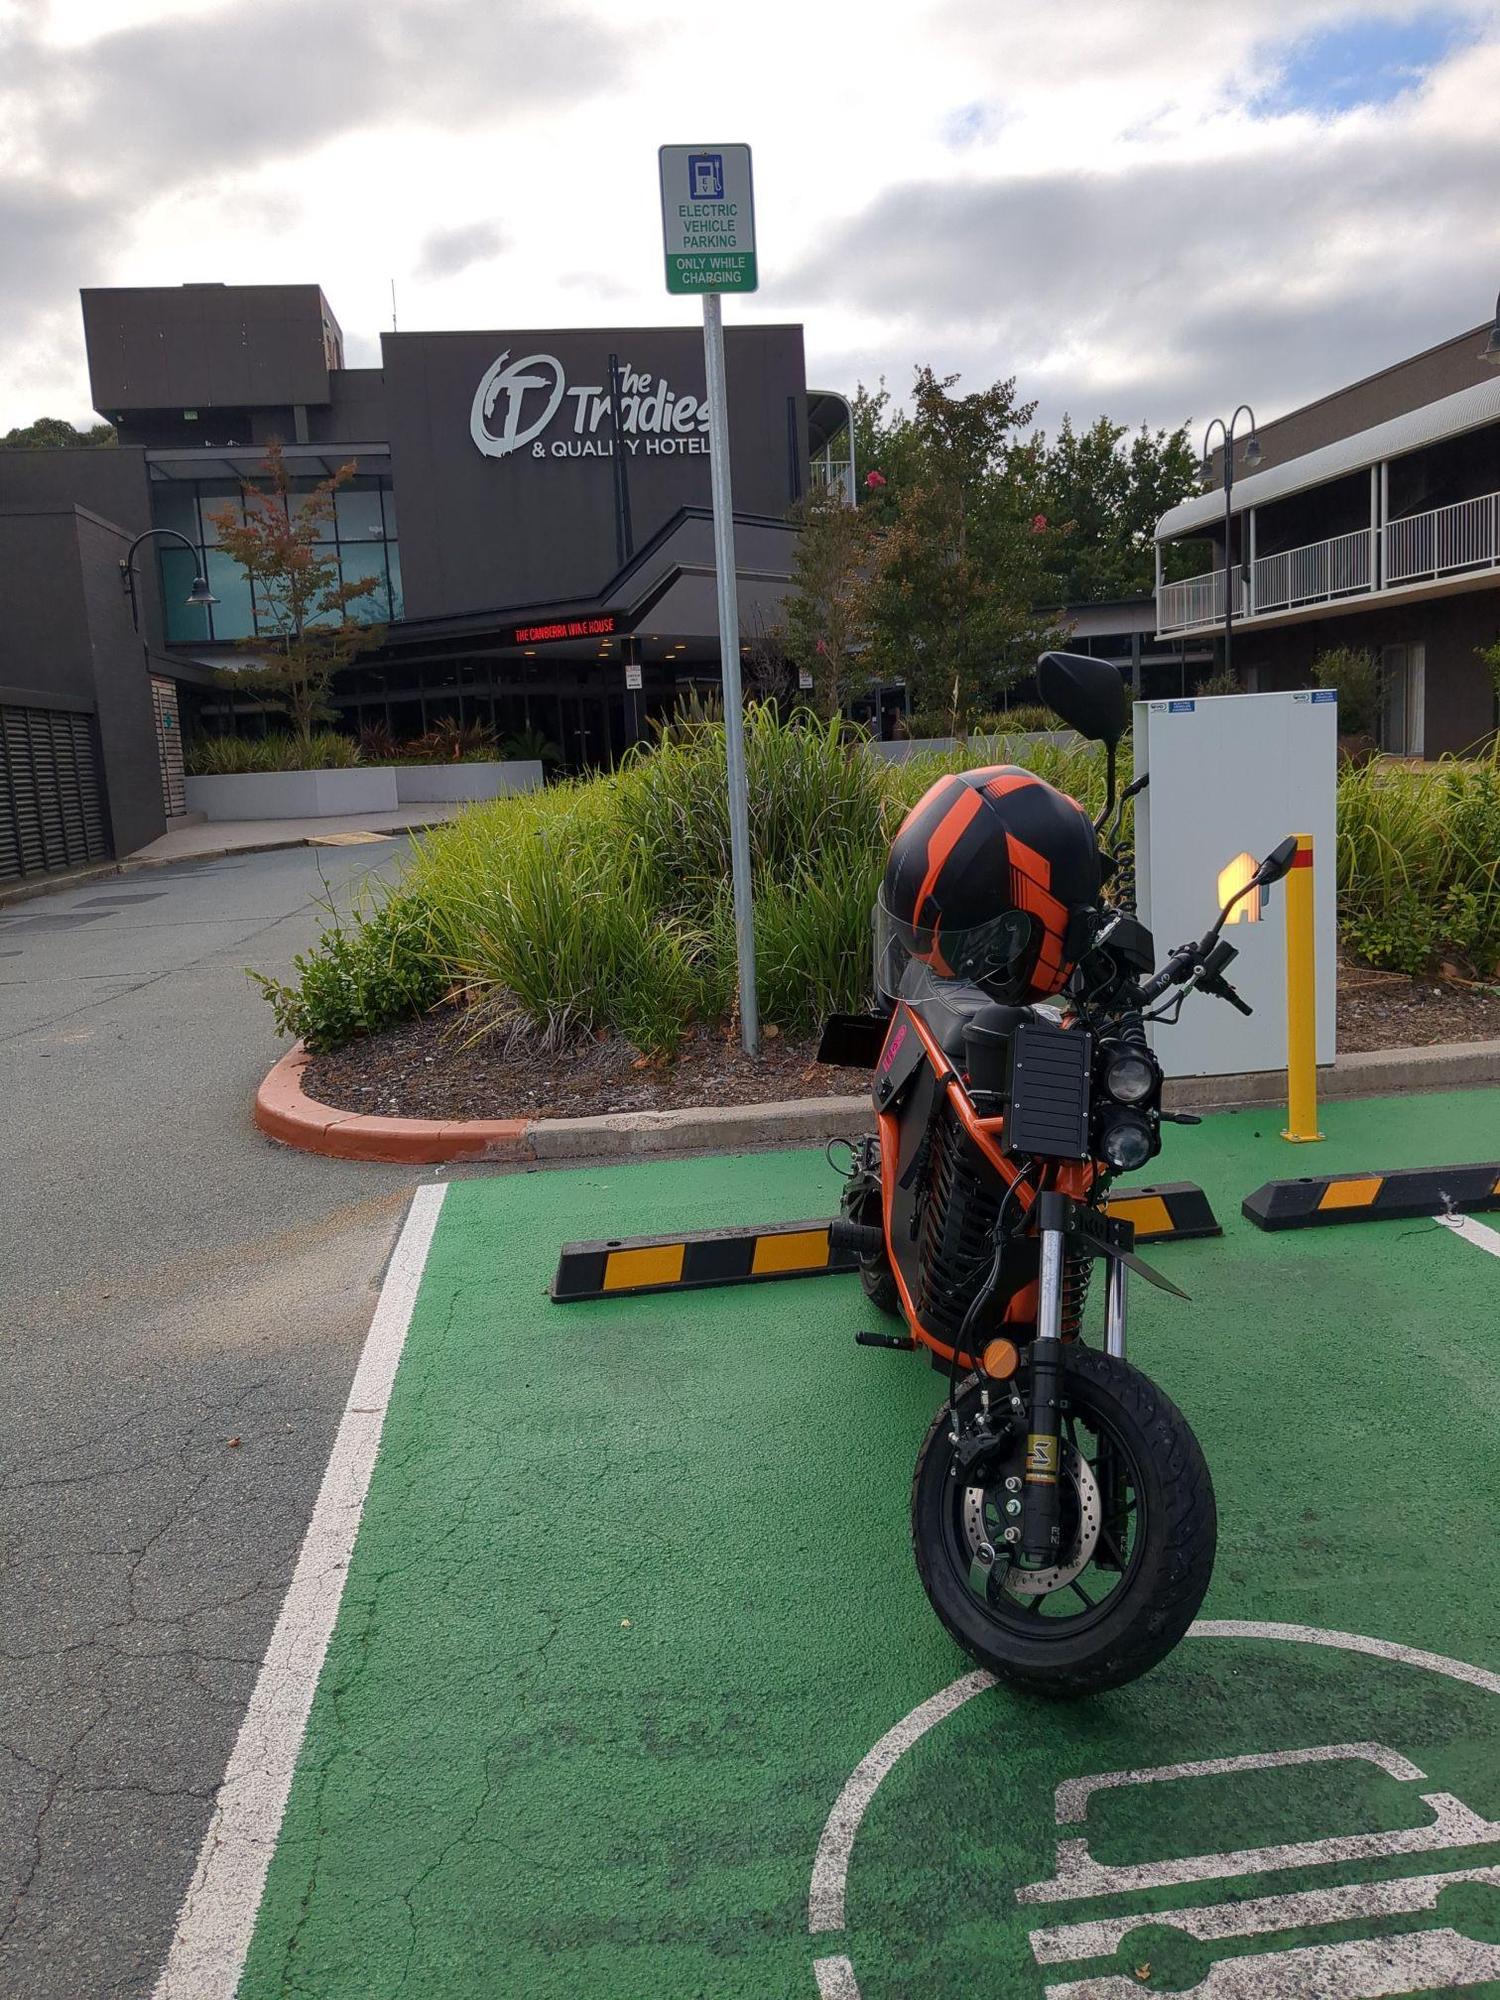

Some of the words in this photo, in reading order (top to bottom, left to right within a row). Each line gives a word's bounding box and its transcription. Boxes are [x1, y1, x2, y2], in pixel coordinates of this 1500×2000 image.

[678, 204, 738, 217] ELECTRIC
[683, 220, 735, 232] VEHICLE
[683, 235, 737, 248] PARKING
[676, 258, 706, 270] ONLY
[710, 256, 746, 269] WHILE
[682, 271, 742, 284] CHARGING
[566, 379, 710, 434] Tradies
[532, 442, 546, 457] &
[551, 439, 640, 458] QUALIY
[646, 437, 711, 455] HOTEL
[515, 629, 529, 642] THE
[530, 624, 567, 640] CANBERRA
[589, 618, 615, 634] HOUSE
